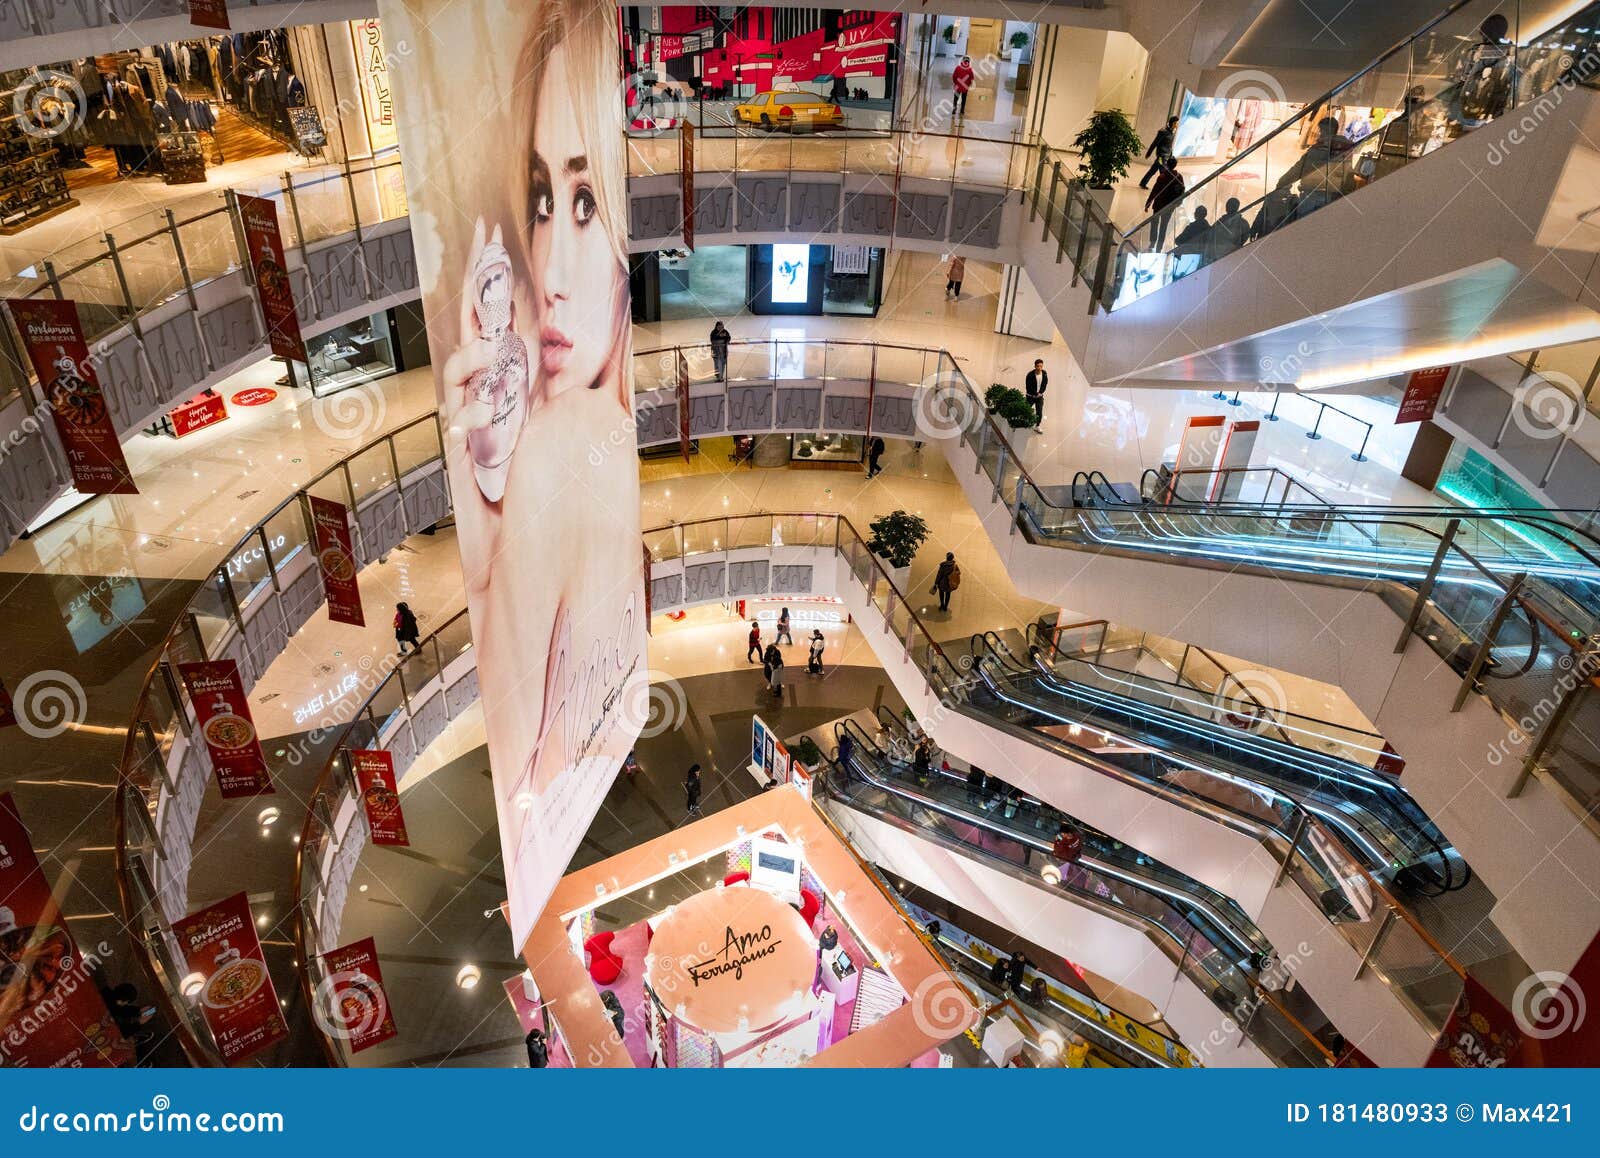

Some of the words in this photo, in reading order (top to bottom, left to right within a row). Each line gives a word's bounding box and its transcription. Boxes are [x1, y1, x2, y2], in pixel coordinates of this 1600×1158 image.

[662, 38, 680, 47] NEW
[848, 28, 867, 44] NY
[662, 47, 682, 57] YORK
[364, 17, 393, 126] SALE
[69, 449, 86, 462] 1F
[216, 767, 233, 776] 1F
[190, 915, 242, 946] Andaman
[716, 925, 771, 960] Amo
[688, 940, 782, 987] Ferragamo
[219, 1027, 238, 1042] 1F
